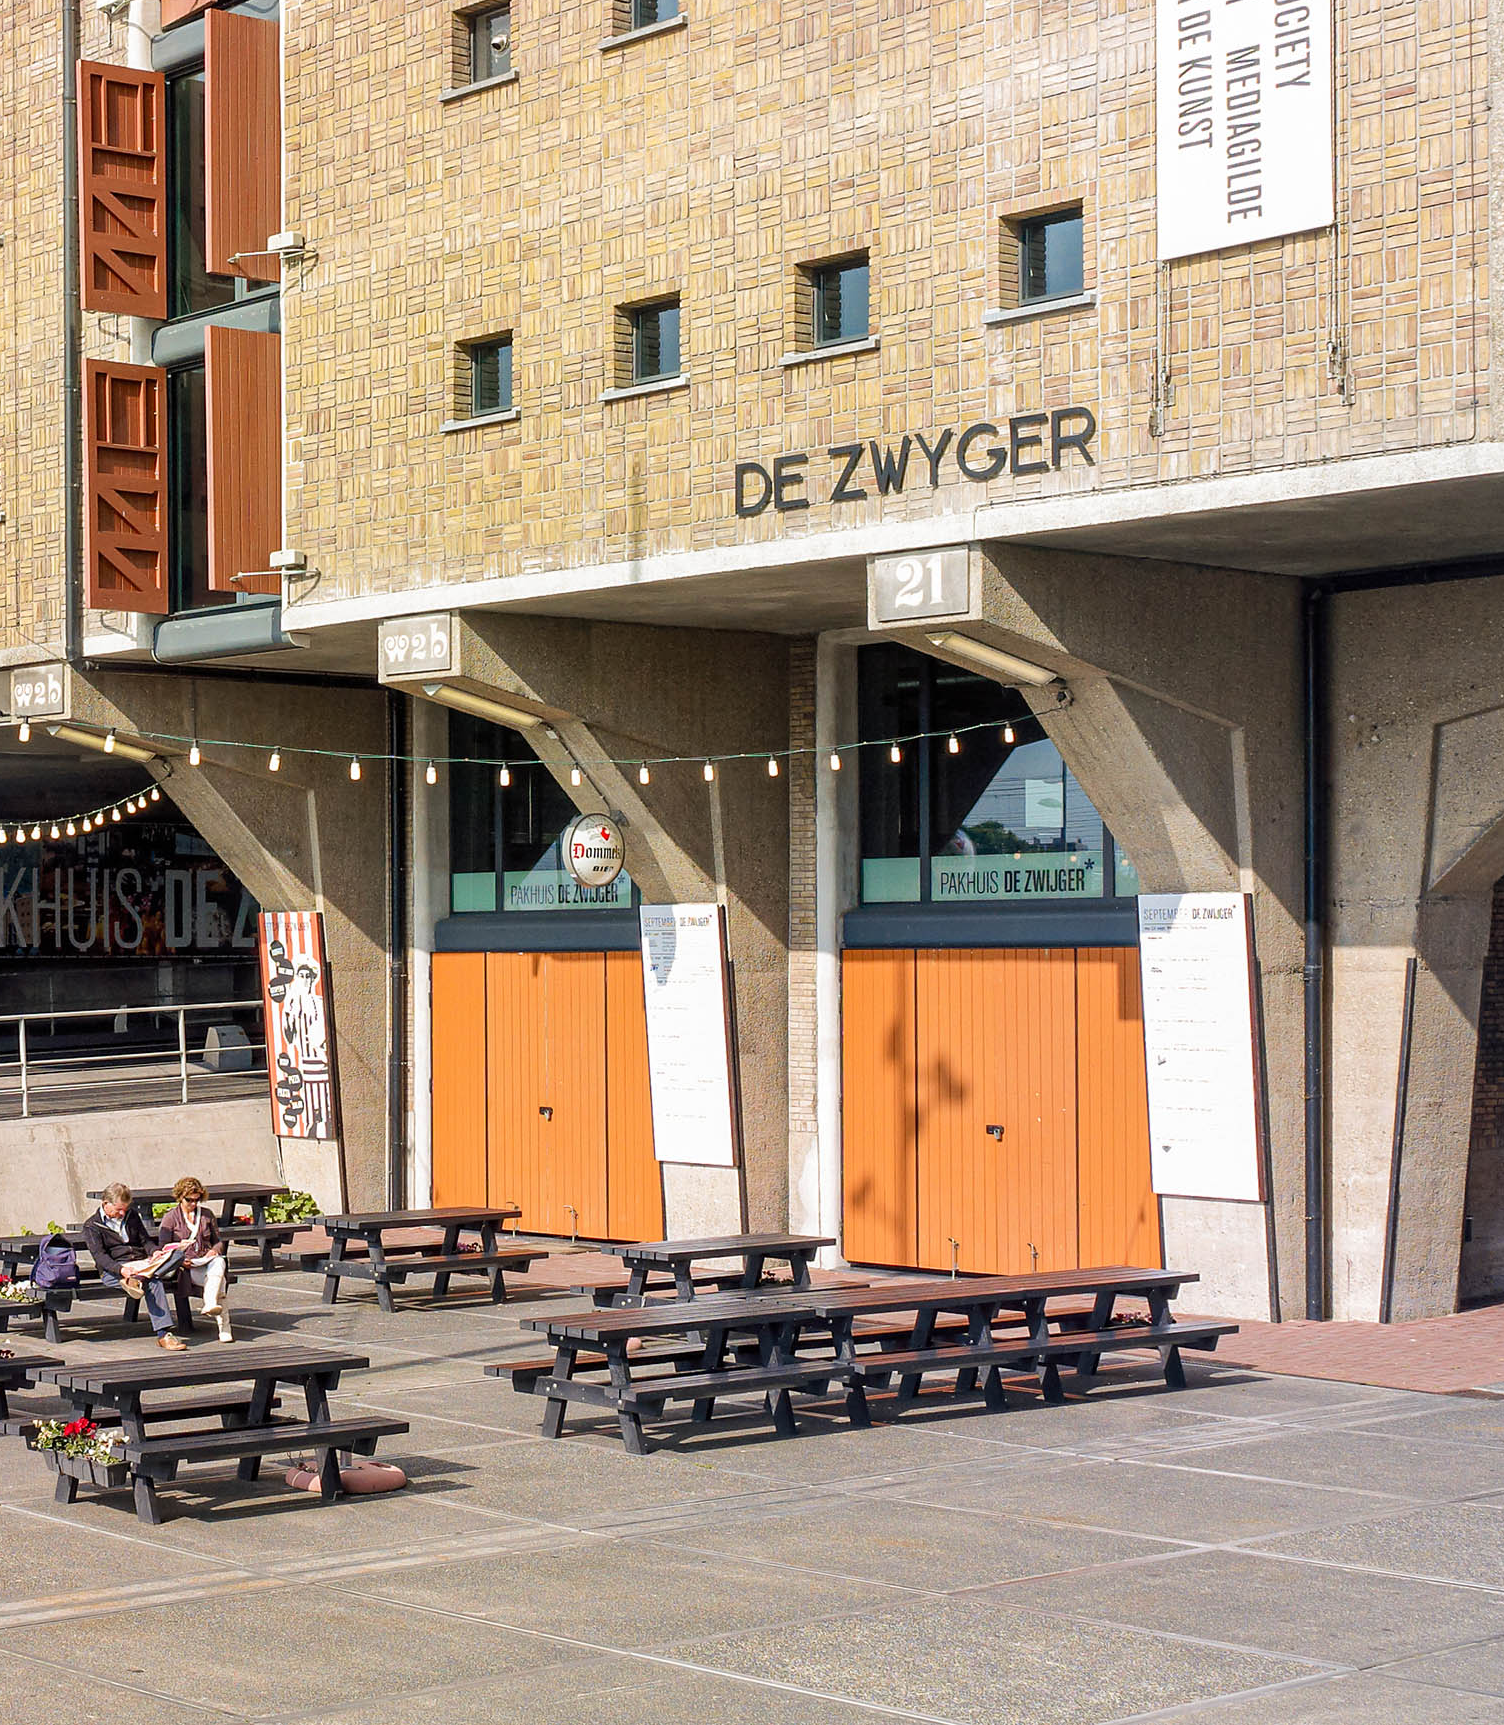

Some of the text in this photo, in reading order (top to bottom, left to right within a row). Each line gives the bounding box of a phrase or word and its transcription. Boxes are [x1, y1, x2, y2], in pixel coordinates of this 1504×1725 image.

[1178, 9, 1212, 51] DE
[1178, 54, 1213, 150] KUNST
[1226, 43, 1263, 224] MEDIAGILDE
[735, 406, 1096, 516] DE ZWYGER
[894, 555, 944, 609] 21
[164, 868, 220, 948] DE
[510, 884, 554, 905] PAKHUIS
[558, 884, 571, 904] DE
[940, 870, 999, 895] PAKHUIS
[1004, 870, 1021, 893] DE
